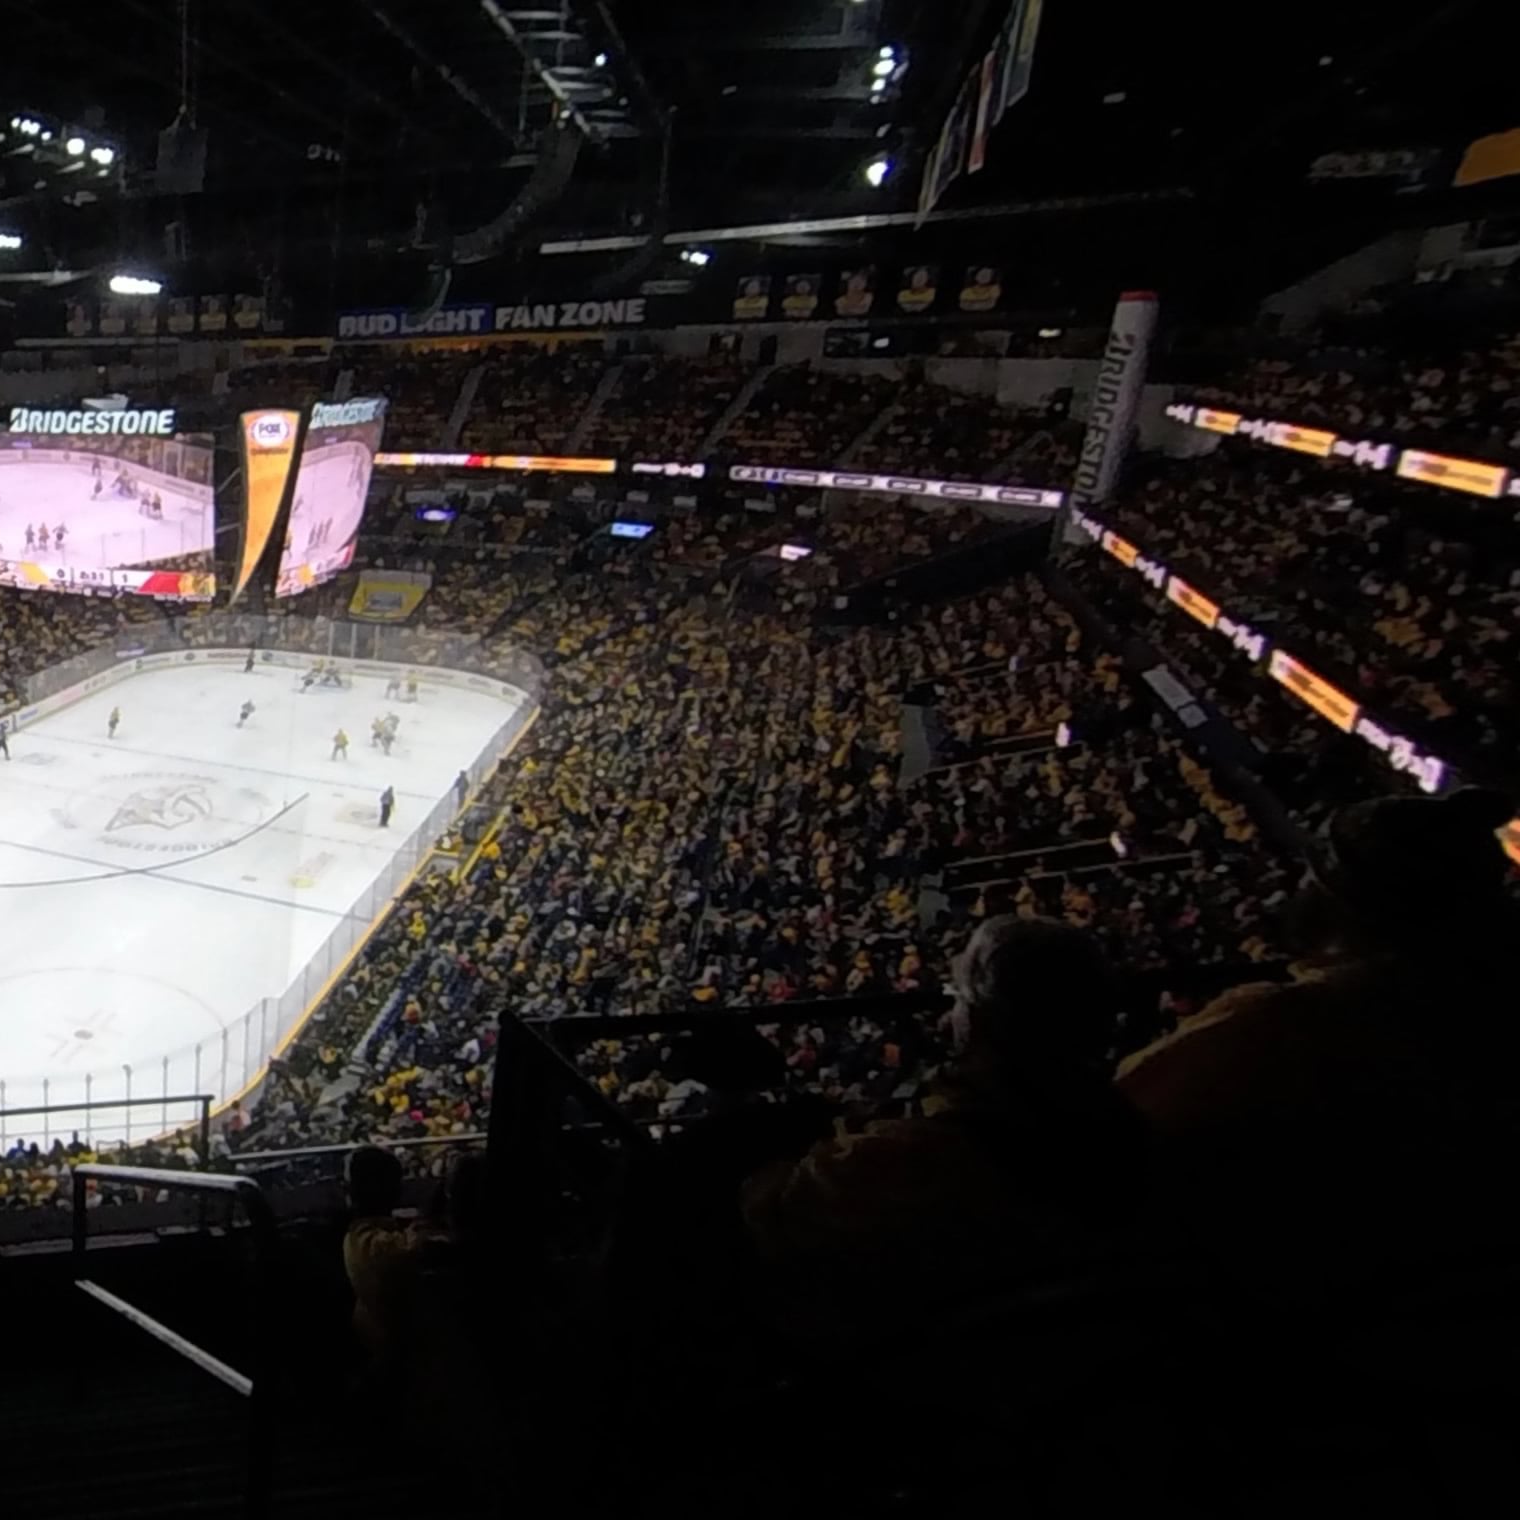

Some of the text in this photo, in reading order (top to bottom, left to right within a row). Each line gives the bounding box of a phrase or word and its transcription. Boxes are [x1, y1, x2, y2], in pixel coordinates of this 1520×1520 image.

[338, 311, 398, 337] BUD
[494, 304, 555, 330] FAN
[555, 298, 647, 326] ZONE
[9, 407, 175, 434] BRIDGESTONE
[259, 423, 281, 434] FOX
